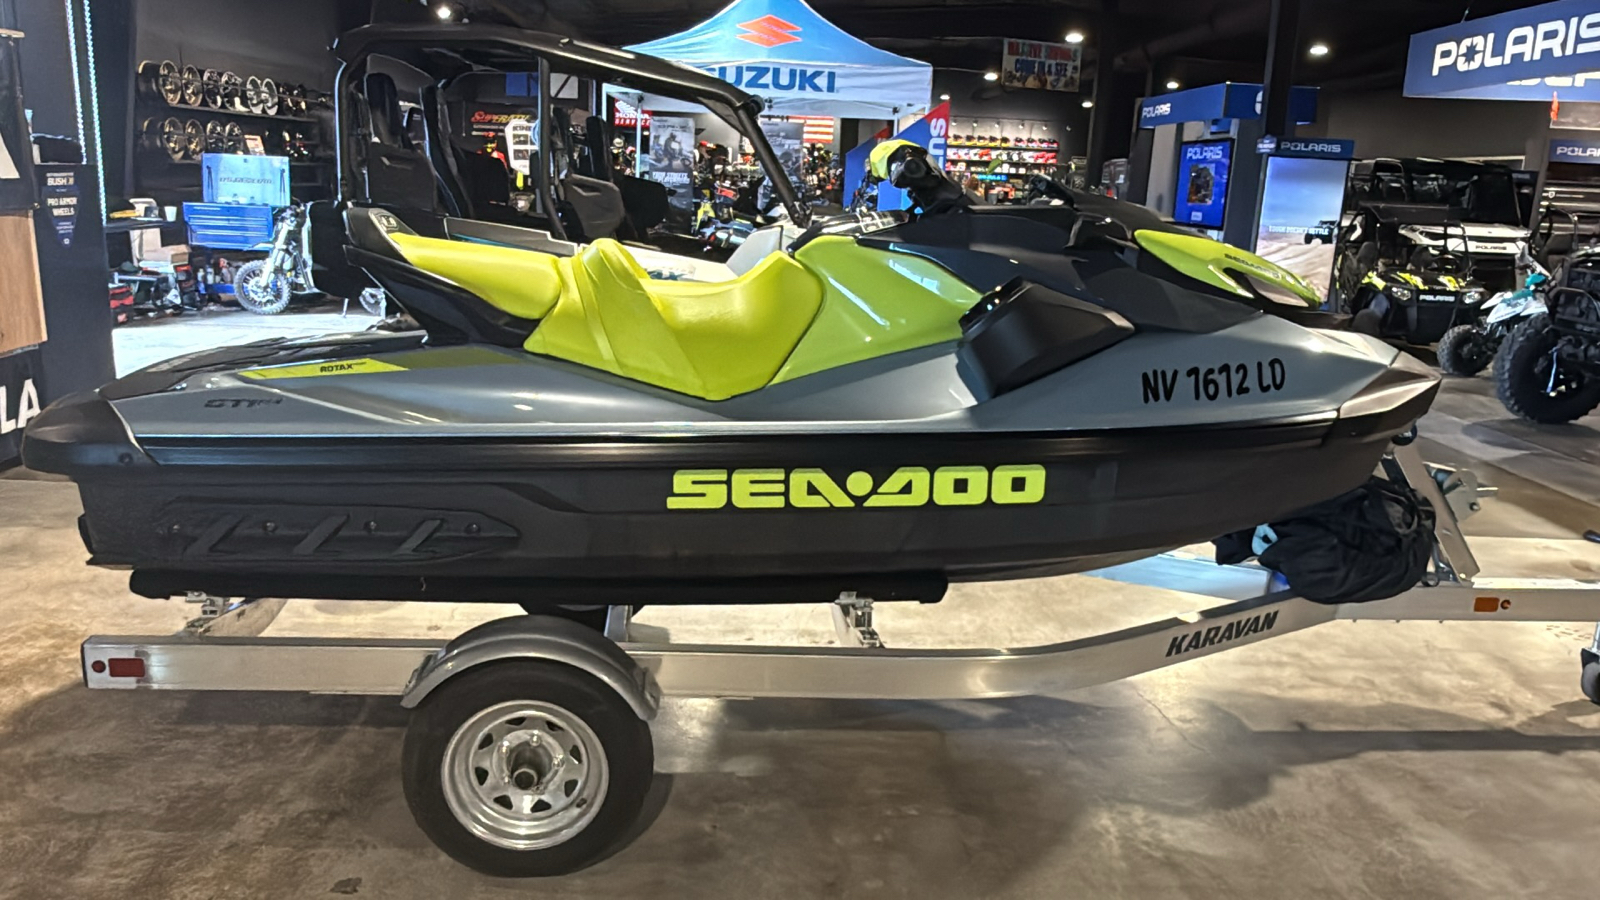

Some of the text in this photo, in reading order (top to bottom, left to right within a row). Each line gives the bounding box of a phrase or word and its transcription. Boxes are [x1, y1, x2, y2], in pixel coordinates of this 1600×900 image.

[1432, 13, 1600, 76] POLARIS
[1142, 103, 1171, 118] POLARIS
[1187, 146, 1223, 159] POLARIS
[1281, 142, 1342, 153] POLARIS
[1419, 294, 1455, 302] POLARIS
[320, 363, 354, 373] ROTAX
[1142, 369, 1178, 404] NV
[1186, 363, 1250, 401] 1612
[1165, 610, 1279, 657] KARAVAN
